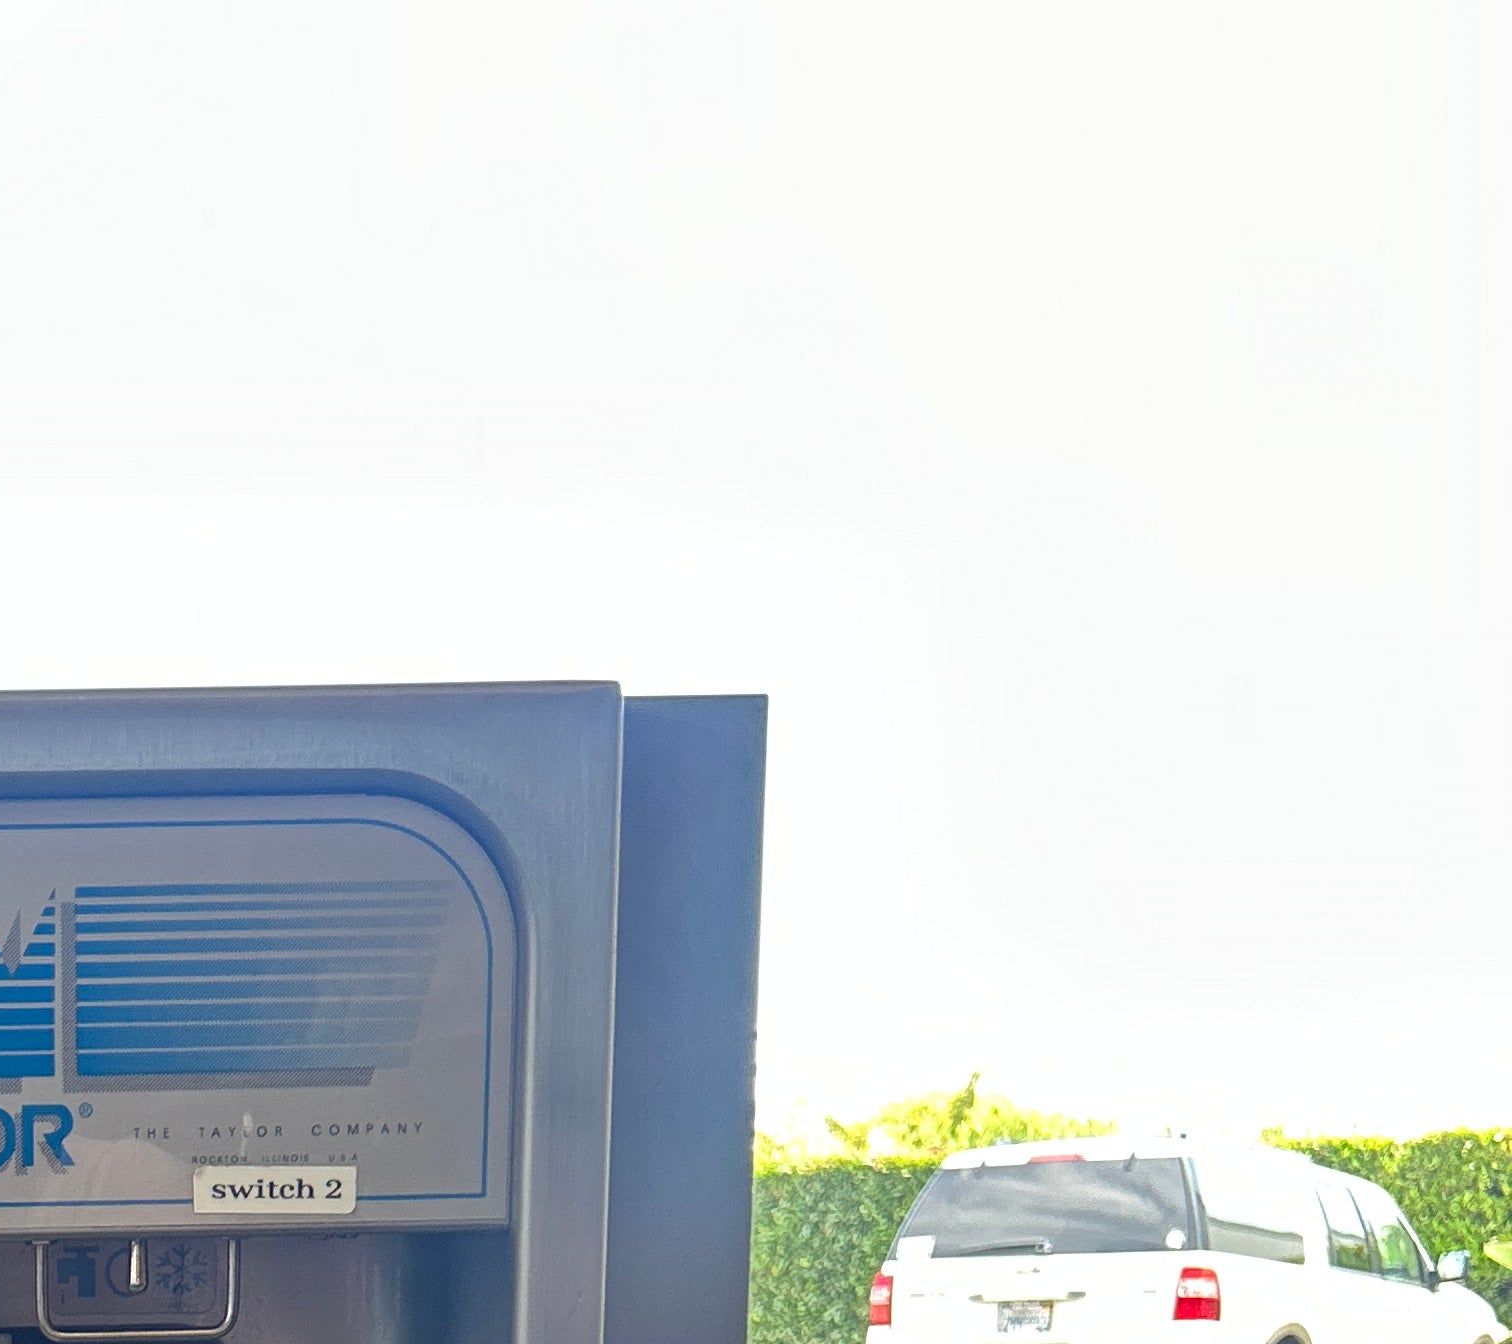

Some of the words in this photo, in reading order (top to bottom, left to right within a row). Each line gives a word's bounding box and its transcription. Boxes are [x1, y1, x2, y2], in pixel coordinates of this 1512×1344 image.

[133, 1127, 170, 1140] THE
[199, 1124, 284, 1138] TAYLOR
[312, 1122, 424, 1136] COMPANY
[211, 1178, 315, 1200] switch
[324, 1179, 343, 1200] 2
